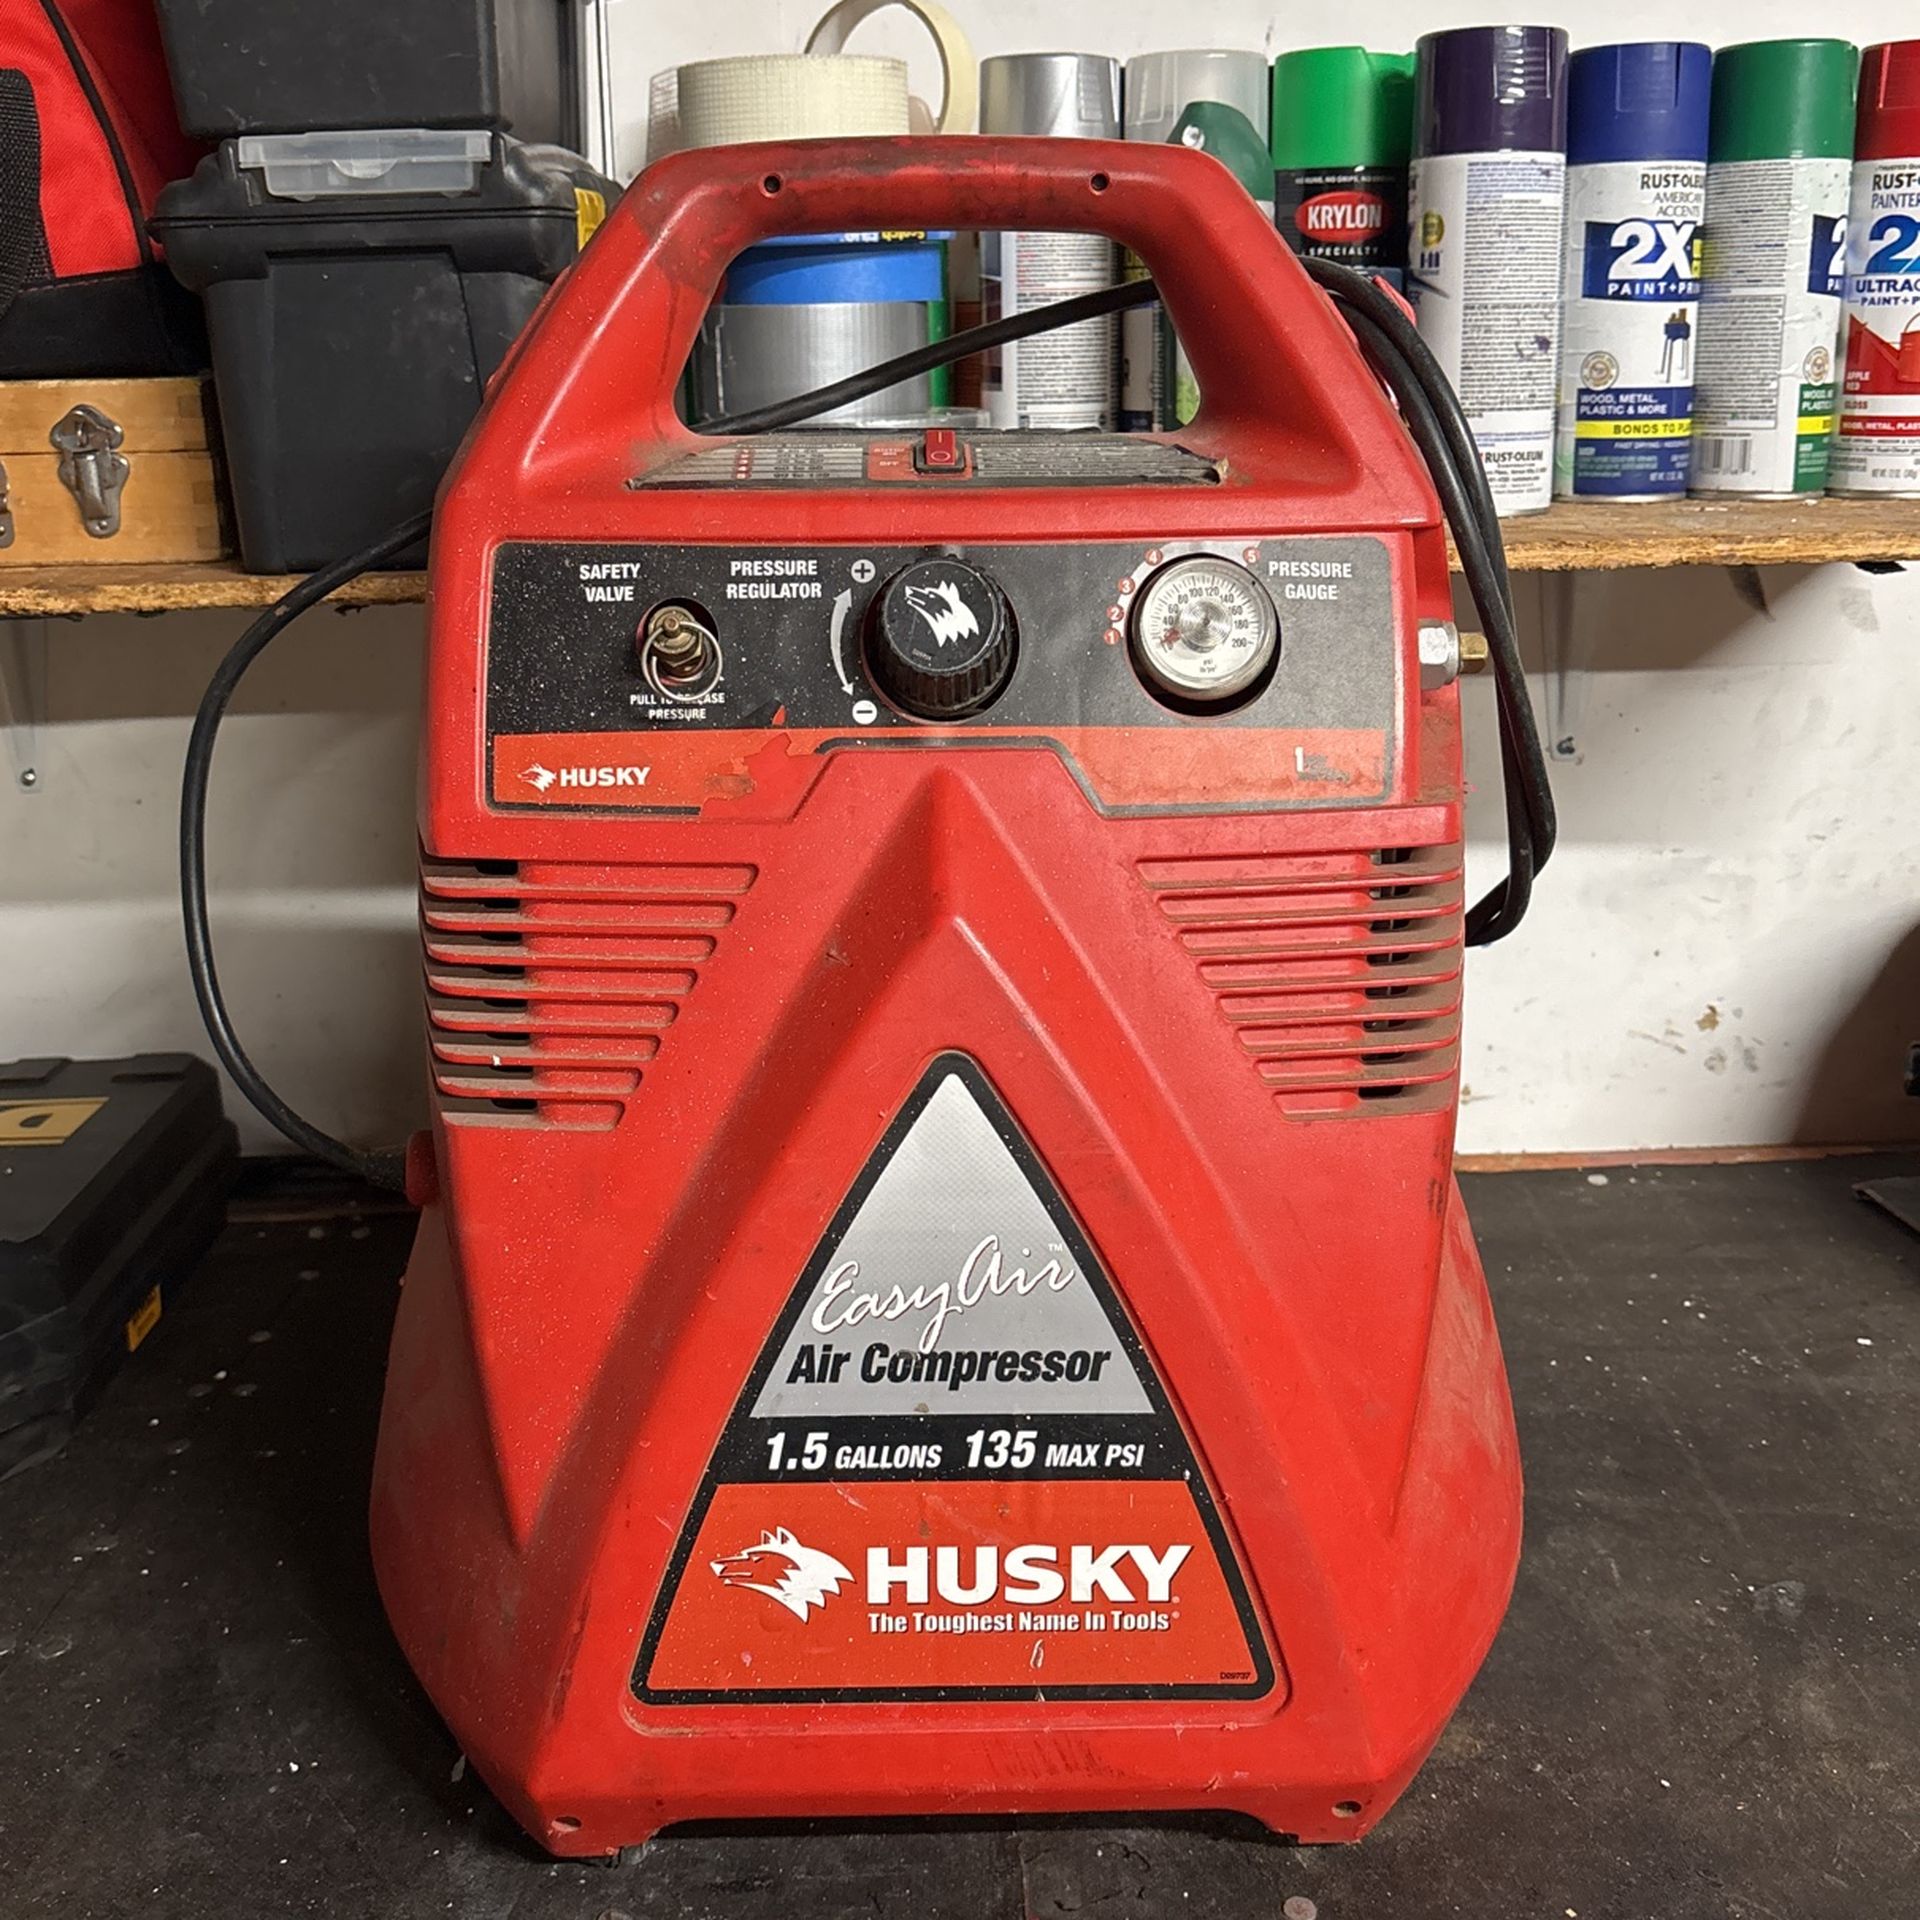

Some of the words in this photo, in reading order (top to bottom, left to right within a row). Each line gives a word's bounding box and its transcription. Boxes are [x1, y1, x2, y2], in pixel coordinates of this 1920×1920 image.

[1872, 173, 1920, 191] RUST-
[1308, 204, 1382, 230] KRYLON
[1309, 246, 1378, 256] SPECIALTY
[1608, 220, 1697, 280] 2X
[1580, 394, 1616, 404] WOOD,
[1580, 405, 1624, 415] PLASTIC
[1627, 405, 1634, 414] &
[1637, 404, 1667, 414] MORE
[1613, 424, 1658, 435] BONDS
[579, 563, 641, 580] SAFETY
[731, 560, 818, 576] PRESSURE
[1269, 561, 1353, 578] PRESSURE
[585, 586, 635, 602] VALVE
[726, 583, 822, 599] REGULATOR
[1178, 593, 1189, 604] 80
[1189, 587, 1203, 597] 100
[1205, 586, 1219, 597] 120
[1285, 584, 1338, 600] GAUGE
[1168, 603, 1179, 614] 60
[1163, 615, 1174, 626] 40
[1234, 619, 1249, 629] 180
[1232, 637, 1247, 648] 200
[630, 694, 657, 704] PULL
[649, 708, 706, 720] PRESSURE
[560, 767, 650, 787] HUSKY
[811, 1260, 962, 1353] Easy
[957, 1234, 1074, 1306] Air
[786, 1344, 849, 1383] Air
[861, 1343, 1111, 1391] Compressor
[766, 1432, 829, 1470] 1.5
[835, 1445, 942, 1469] GALLONS
[965, 1430, 1037, 1468] 135
[1045, 1444, 1100, 1467] MAX
[1105, 1444, 1144, 1467] PSI
[867, 1545, 1192, 1604] HUSKY
[869, 1613, 907, 1632] The
[912, 1612, 1013, 1635] Toughest
[1018, 1612, 1078, 1631] Name
[1085, 1611, 1105, 1630] In
[1111, 1610, 1169, 1630] Tools
